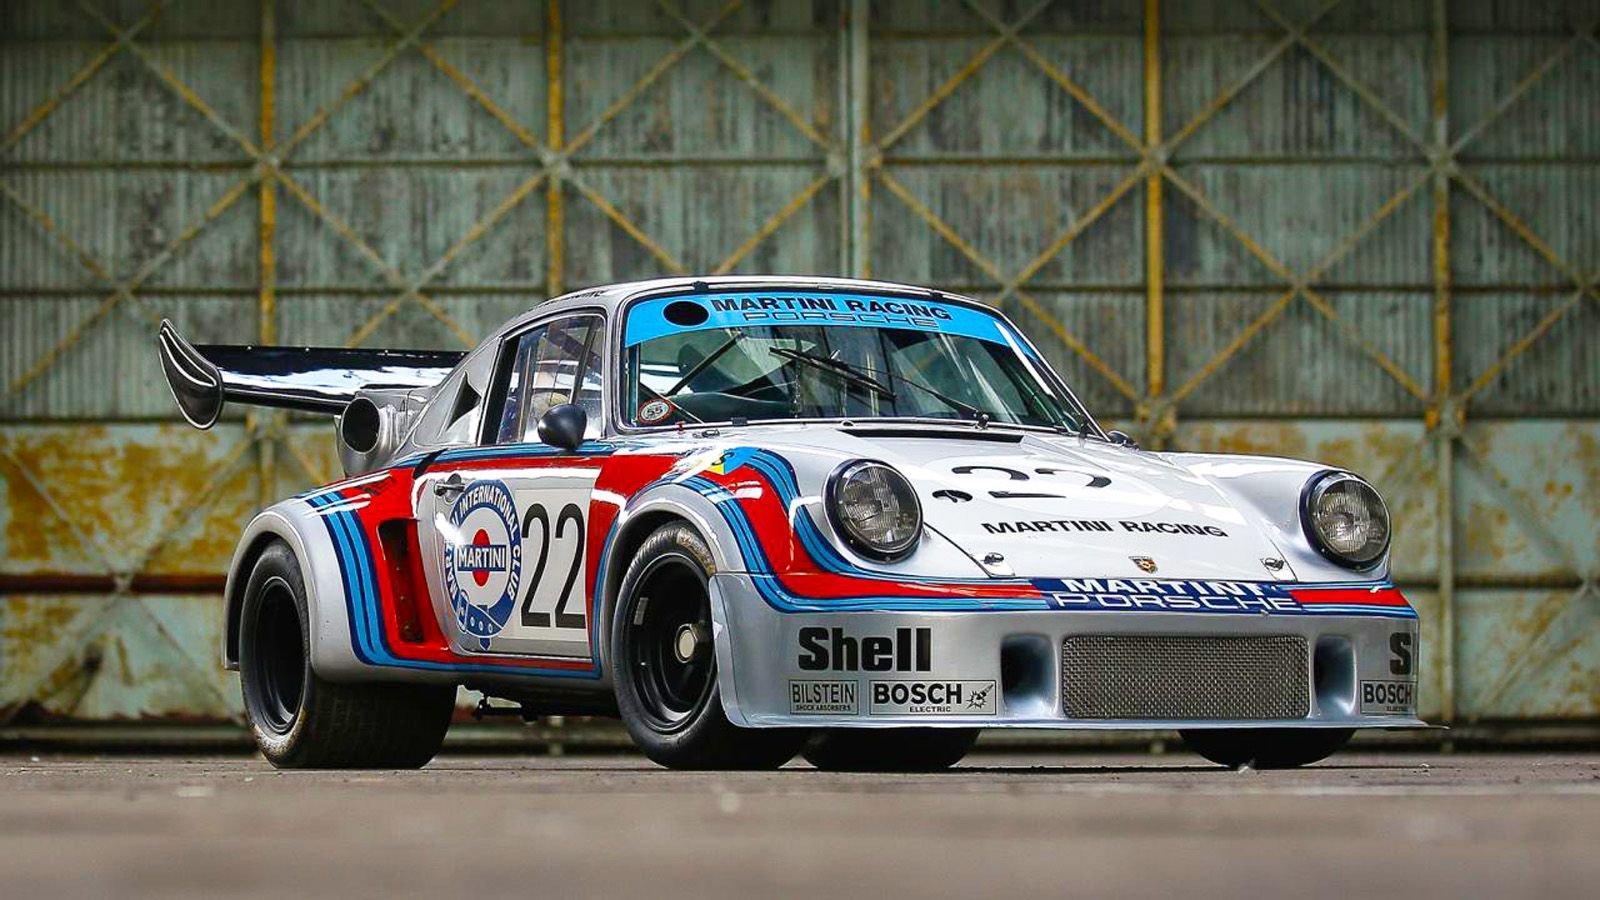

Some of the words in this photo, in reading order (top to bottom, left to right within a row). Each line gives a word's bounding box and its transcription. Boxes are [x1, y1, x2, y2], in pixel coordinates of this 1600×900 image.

[710, 297, 836, 311] MARTINI
[846, 300, 952, 320] RACING
[743, 312, 940, 329] PORSCHE
[981, 520, 1115, 535] MARTINI
[1118, 520, 1228, 538] RACING
[460, 484, 518, 541] INTERNATIONAL
[507, 544, 521, 601] CLUB
[457, 547, 506, 569] MARTINI
[521, 503, 586, 628] 22
[1060, 579, 1265, 596] MARTINI
[1052, 593, 1302, 611] PORSCHE
[798, 627, 932, 671] Shell
[1389, 632, 1412, 675] S
[792, 683, 855, 703] BILSTEIN
[873, 683, 963, 704] BOSCH
[1363, 683, 1413, 704] BOSCH
